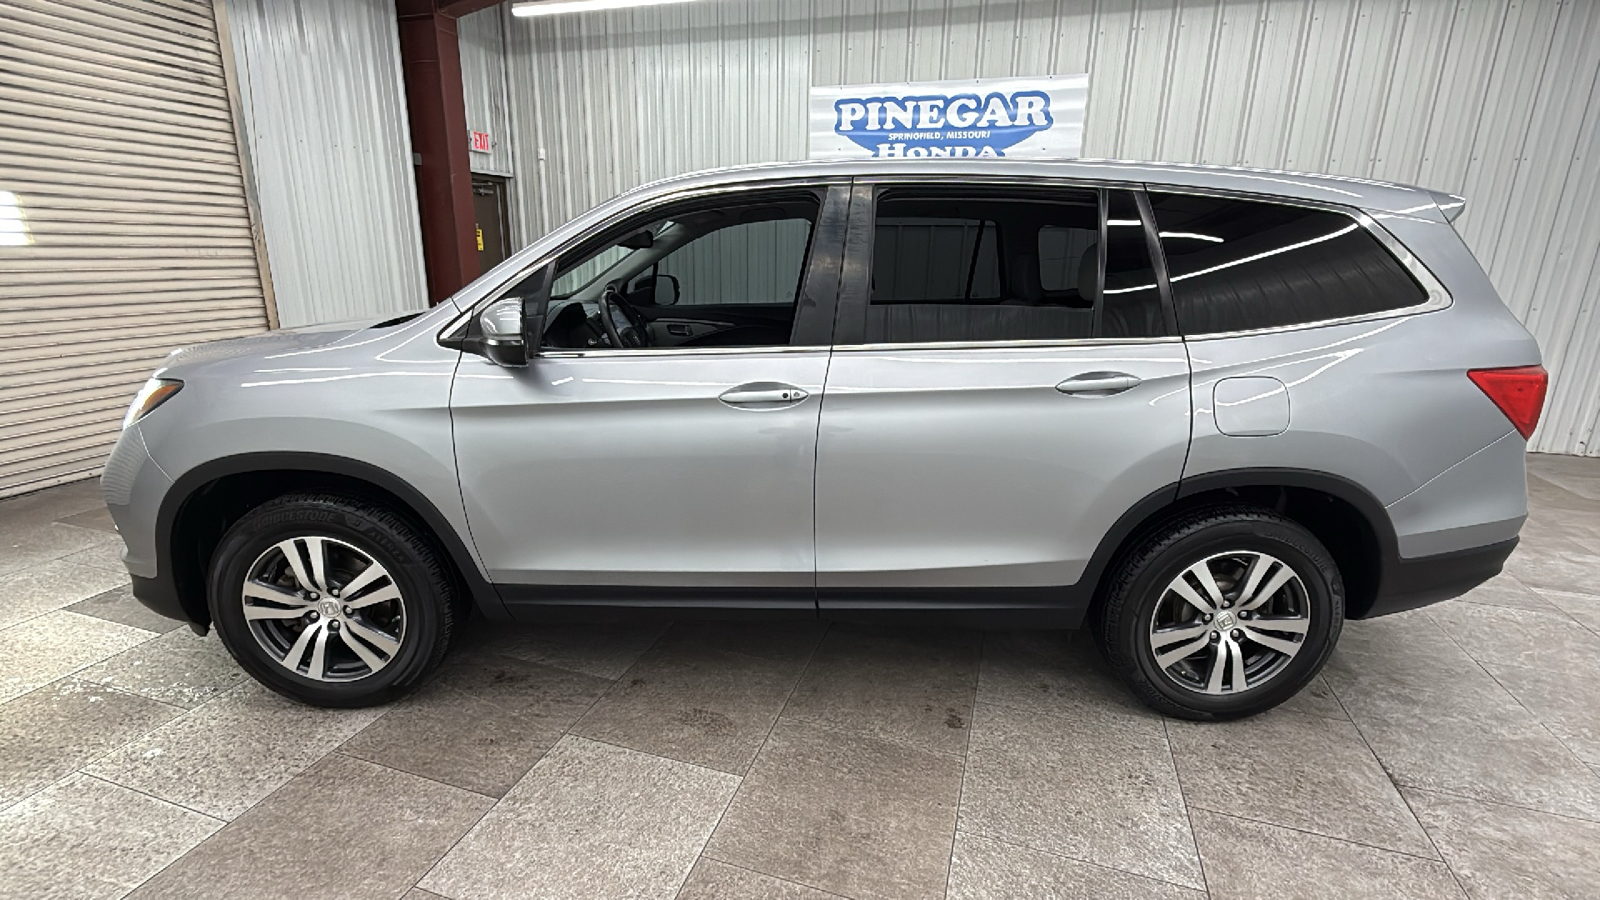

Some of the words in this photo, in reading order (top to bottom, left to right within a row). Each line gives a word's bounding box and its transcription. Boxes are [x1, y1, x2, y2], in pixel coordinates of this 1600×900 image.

[838, 96, 1049, 131] PINEGAR
[473, 131, 489, 151] EXIT
[888, 132, 944, 141] SPRINGFIELD,
[946, 131, 991, 140] MISSOURI
